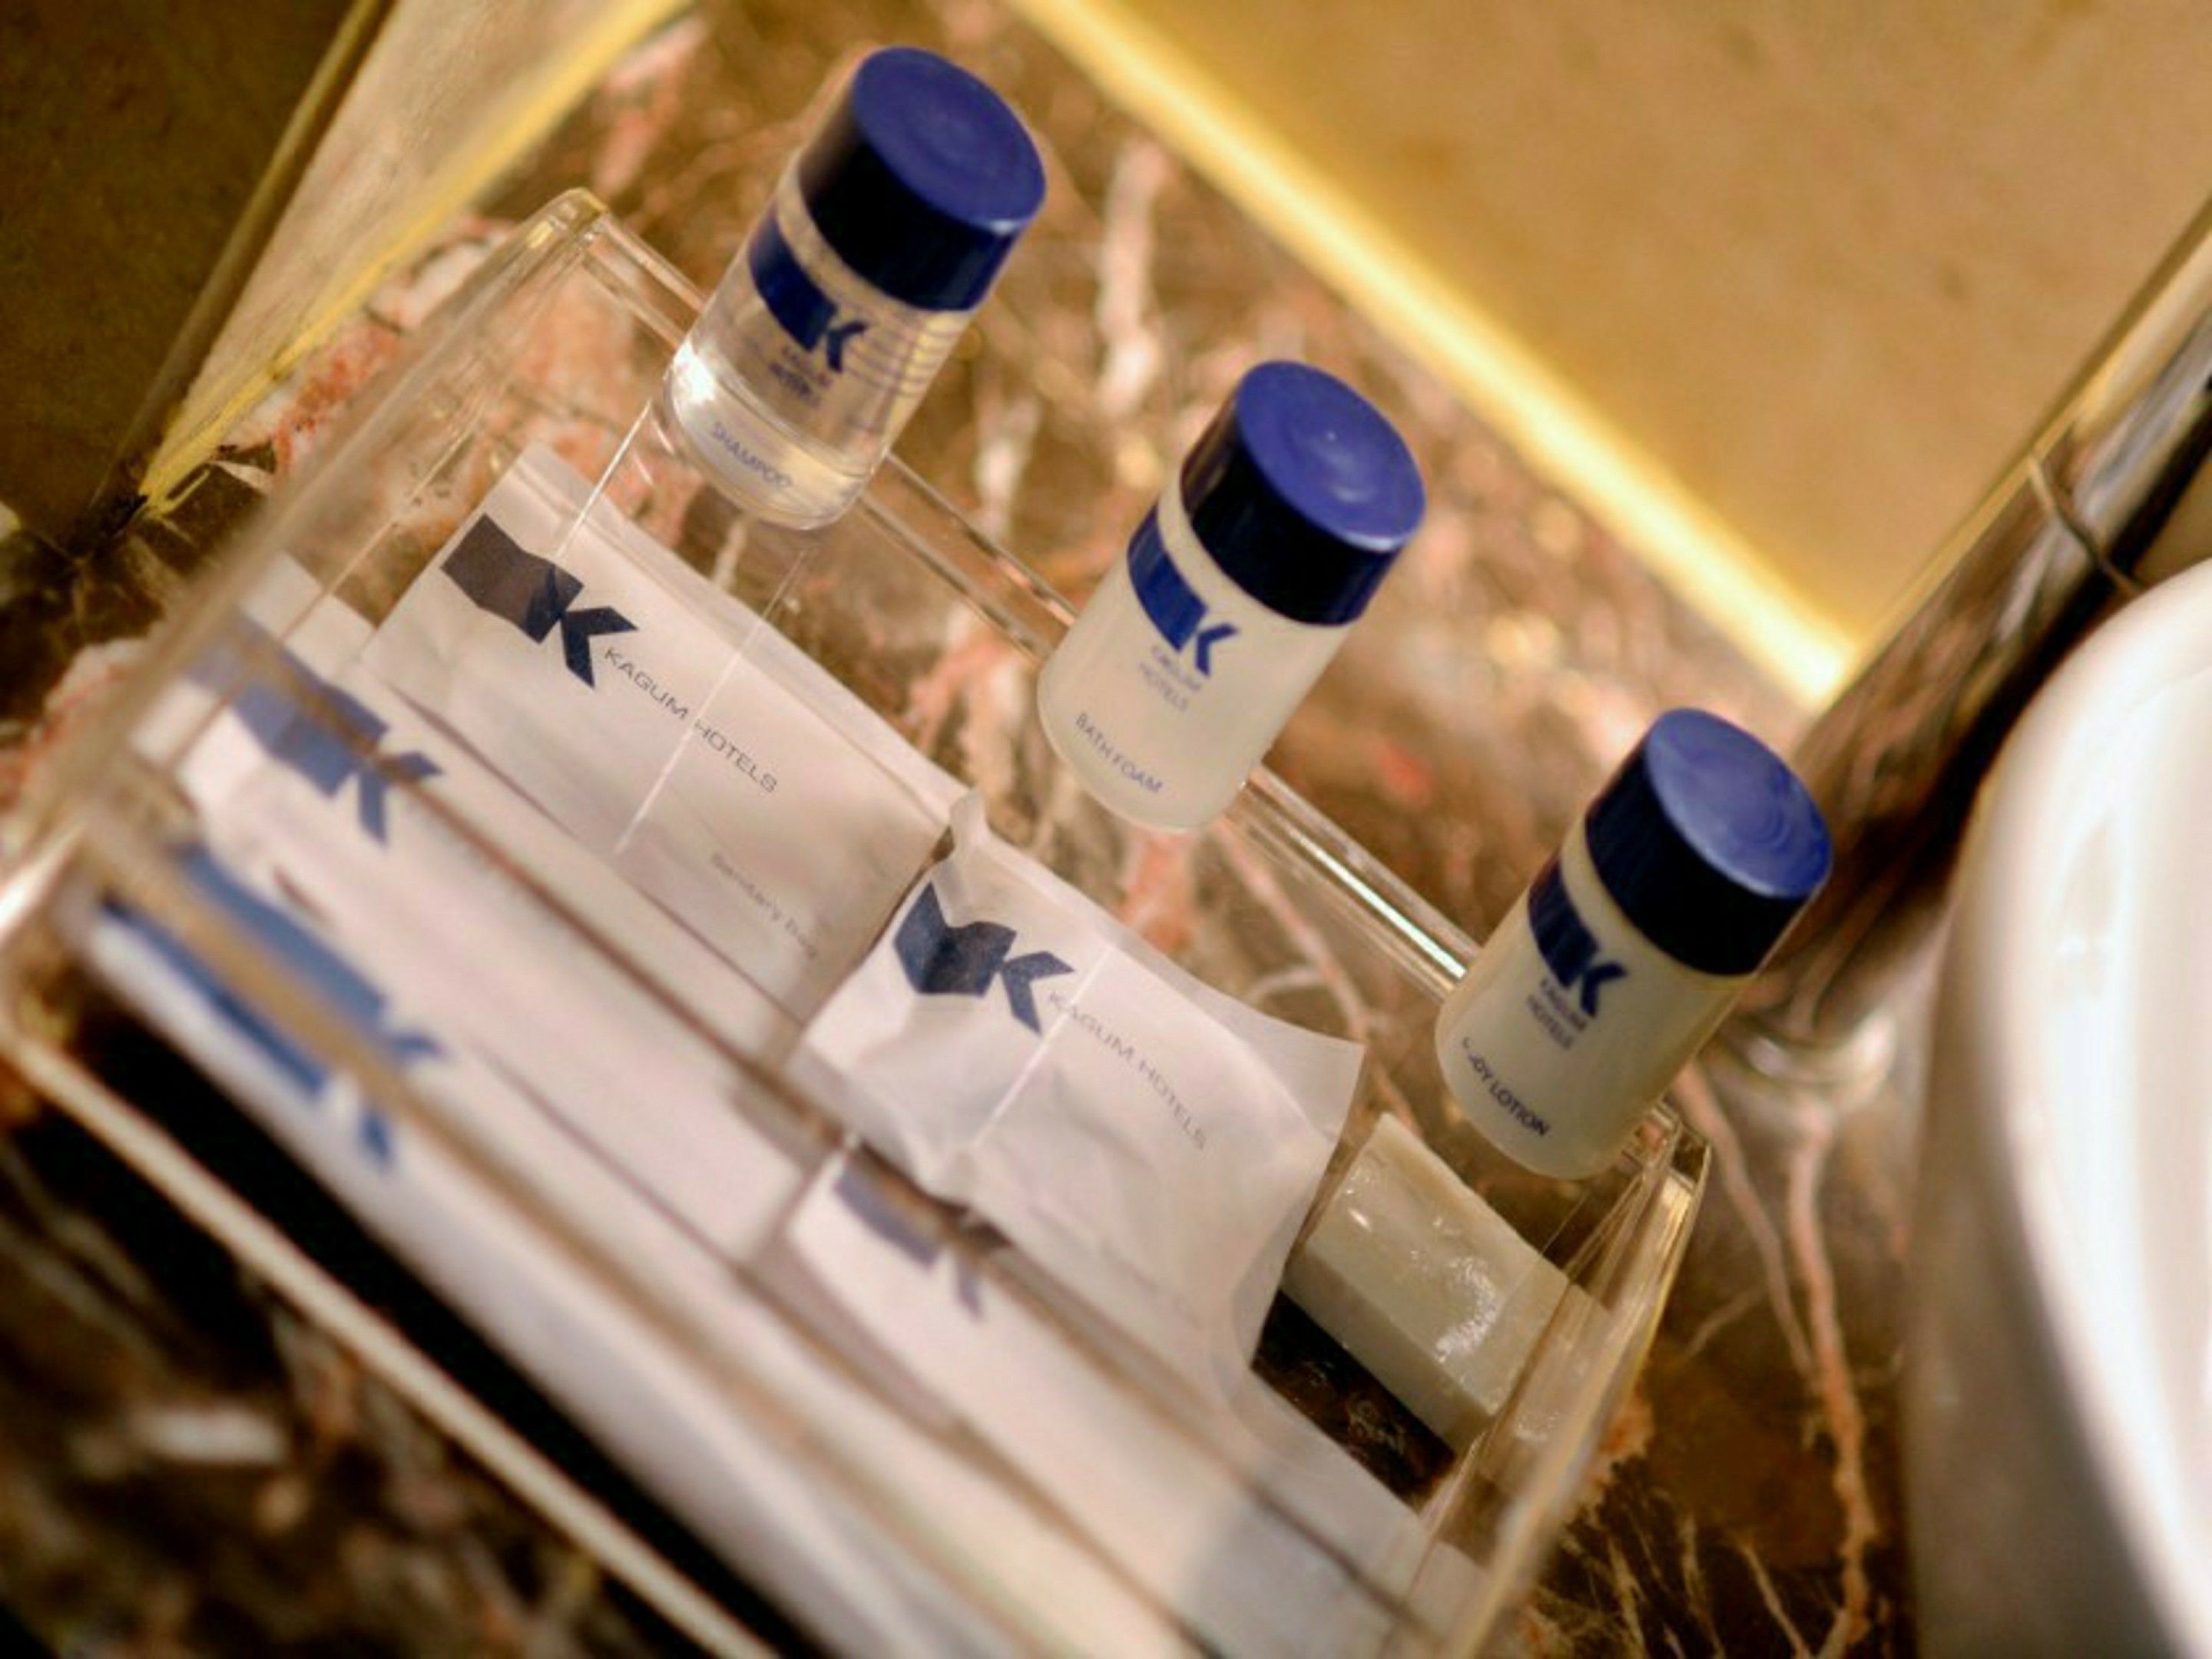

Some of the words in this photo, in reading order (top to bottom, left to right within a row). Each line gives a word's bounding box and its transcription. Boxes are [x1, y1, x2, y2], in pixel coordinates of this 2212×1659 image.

[711, 420, 793, 490] SHAMPOO
[604, 647, 689, 720] KAGUM
[694, 717, 777, 793] HOTELS
[1075, 711, 1114, 760] BATH
[1111, 753, 1164, 793] FOAM
[1048, 989, 1135, 1063] KAGUM
[1138, 1058, 1207, 1151] HOTELS
[1489, 1078, 1551, 1137] LOTION
